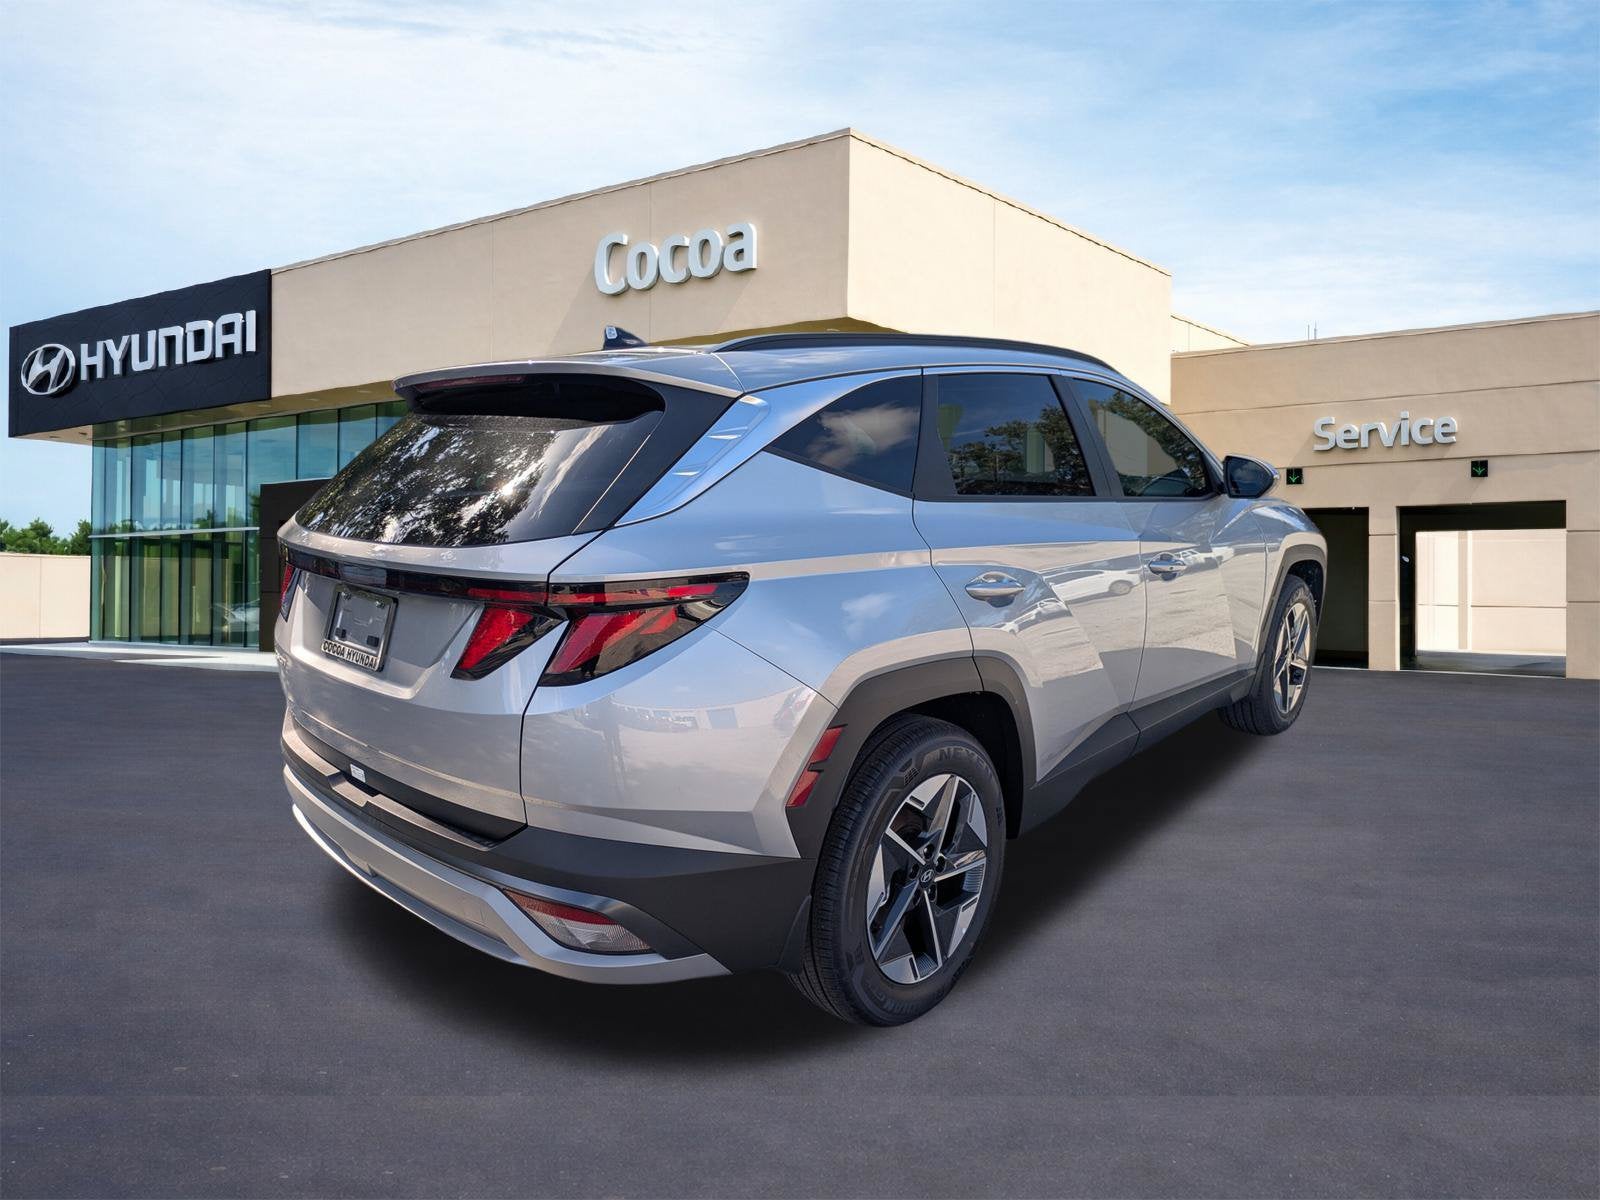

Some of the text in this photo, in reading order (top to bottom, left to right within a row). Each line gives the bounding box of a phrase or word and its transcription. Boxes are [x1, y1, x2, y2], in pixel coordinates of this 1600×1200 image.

[594, 222, 758, 295] Cocoa
[80, 310, 257, 381] HYUNDAI
[1313, 410, 1458, 451] Service
[323, 640, 378, 669] COCOA HYUNDAI
